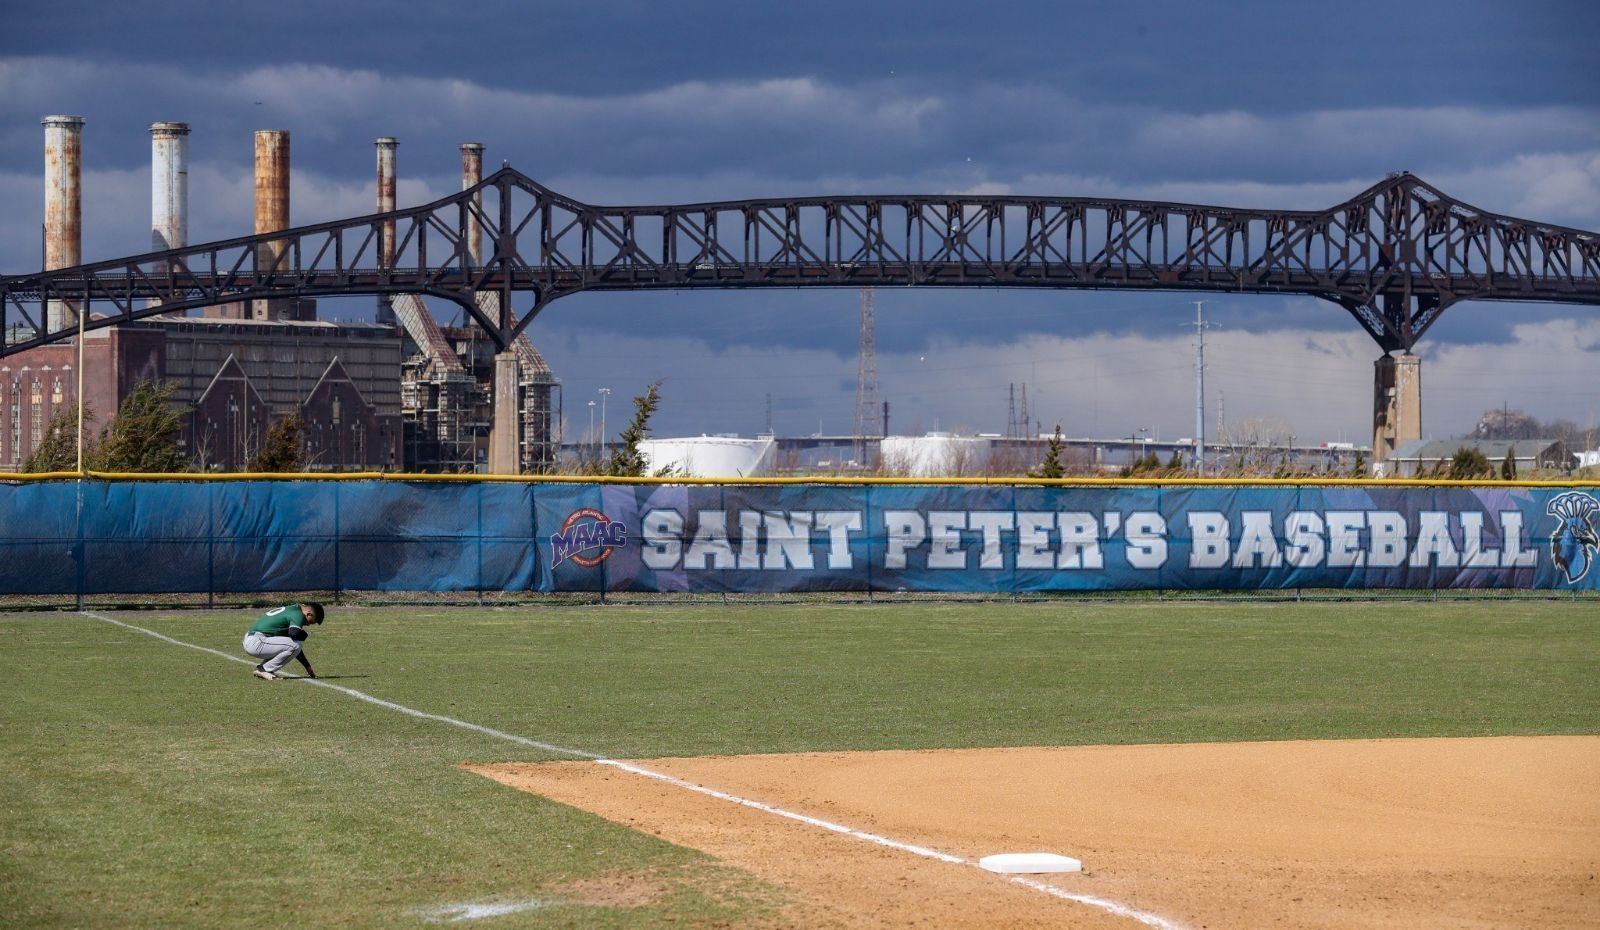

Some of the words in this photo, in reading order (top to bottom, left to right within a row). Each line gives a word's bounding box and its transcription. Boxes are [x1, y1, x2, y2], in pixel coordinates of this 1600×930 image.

[550, 520, 627, 570] MAAC
[640, 508, 863, 570] SAINT
[883, 509, 1169, 570] PETER'S
[1186, 509, 1540, 569] BASEBALL
